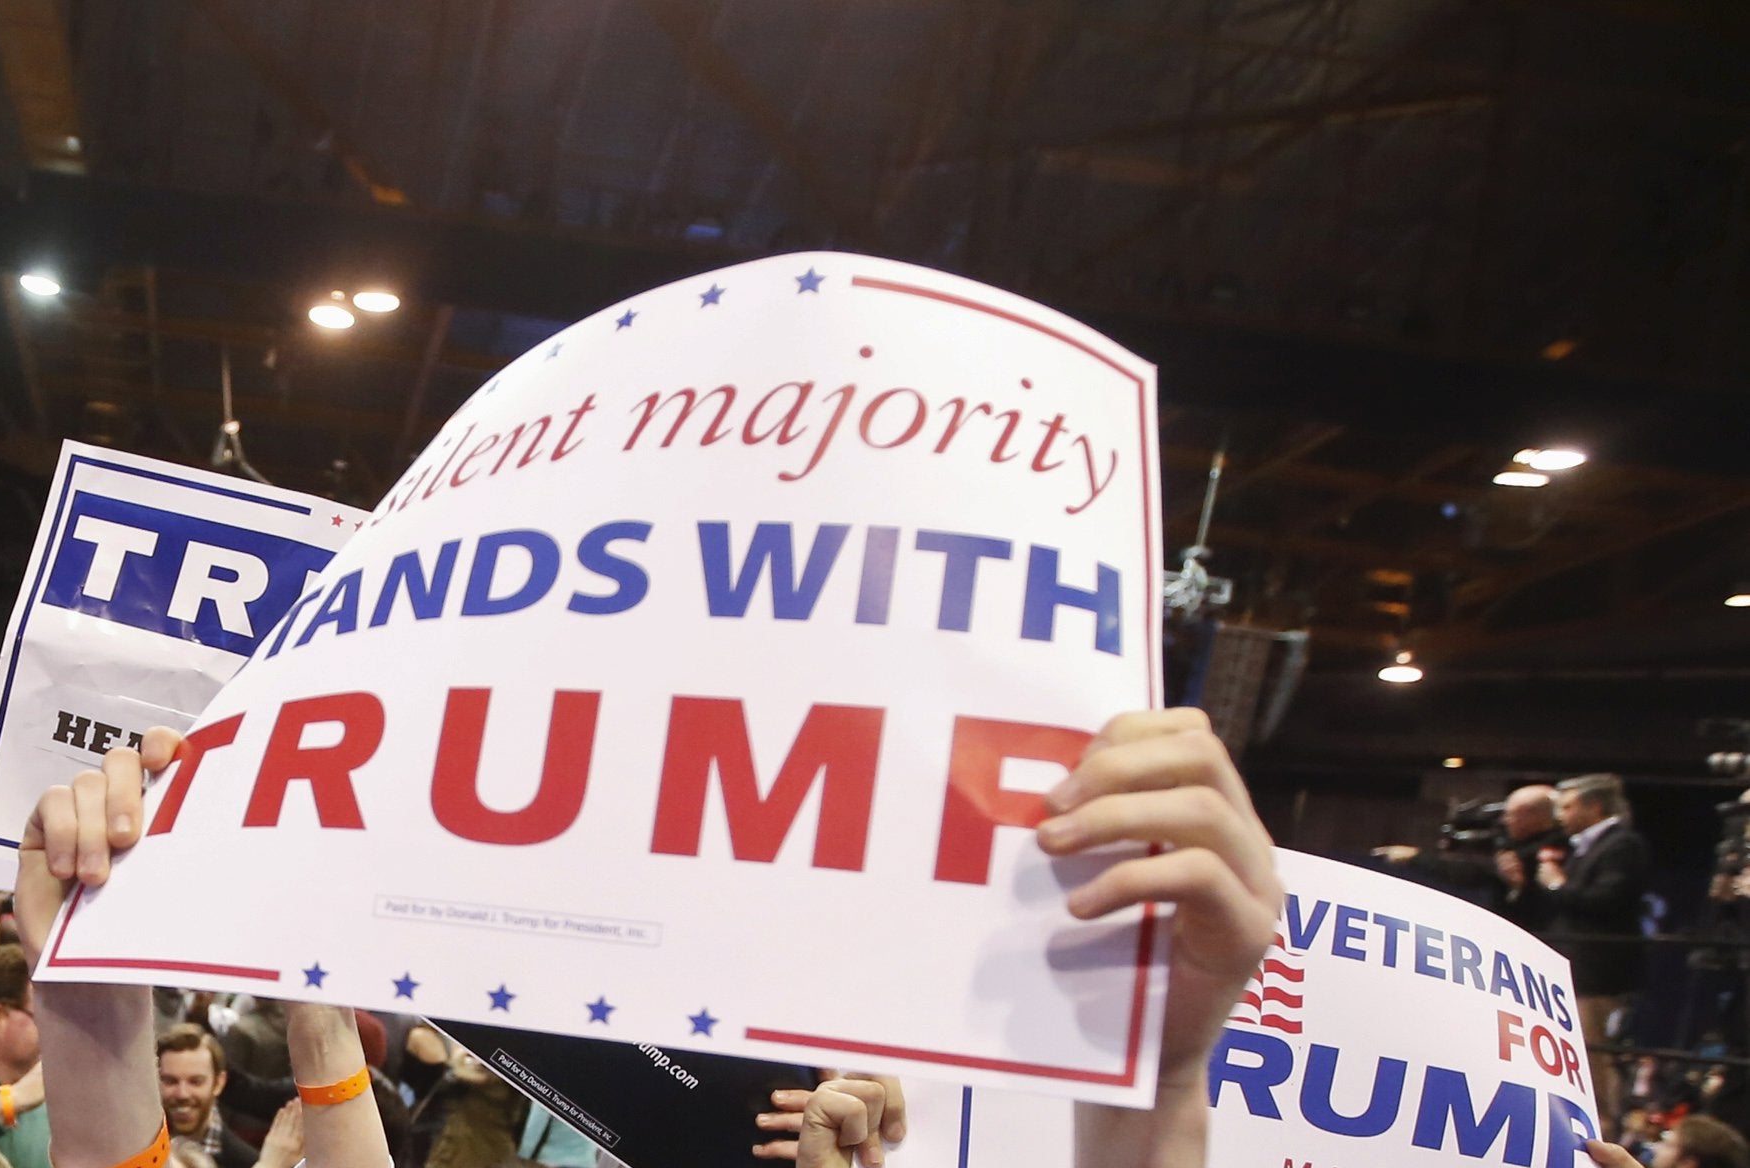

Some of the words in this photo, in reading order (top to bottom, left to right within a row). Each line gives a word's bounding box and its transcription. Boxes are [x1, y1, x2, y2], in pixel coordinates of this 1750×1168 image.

[622, 345, 1118, 515] majority
[72, 515, 320, 638] TR
[696, 519, 1123, 658] WITH
[1283, 893, 1573, 1032] VETERANS
[498, 1054, 513, 1070] Paid
[510, 1063, 521, 1075] for
[519, 1069, 529, 1081] by
[526, 1075, 550, 1097] Donald
[551, 1093, 570, 1113] Trump
[568, 1104, 579, 1117] for
[1497, 1009, 1586, 1094] FOR
